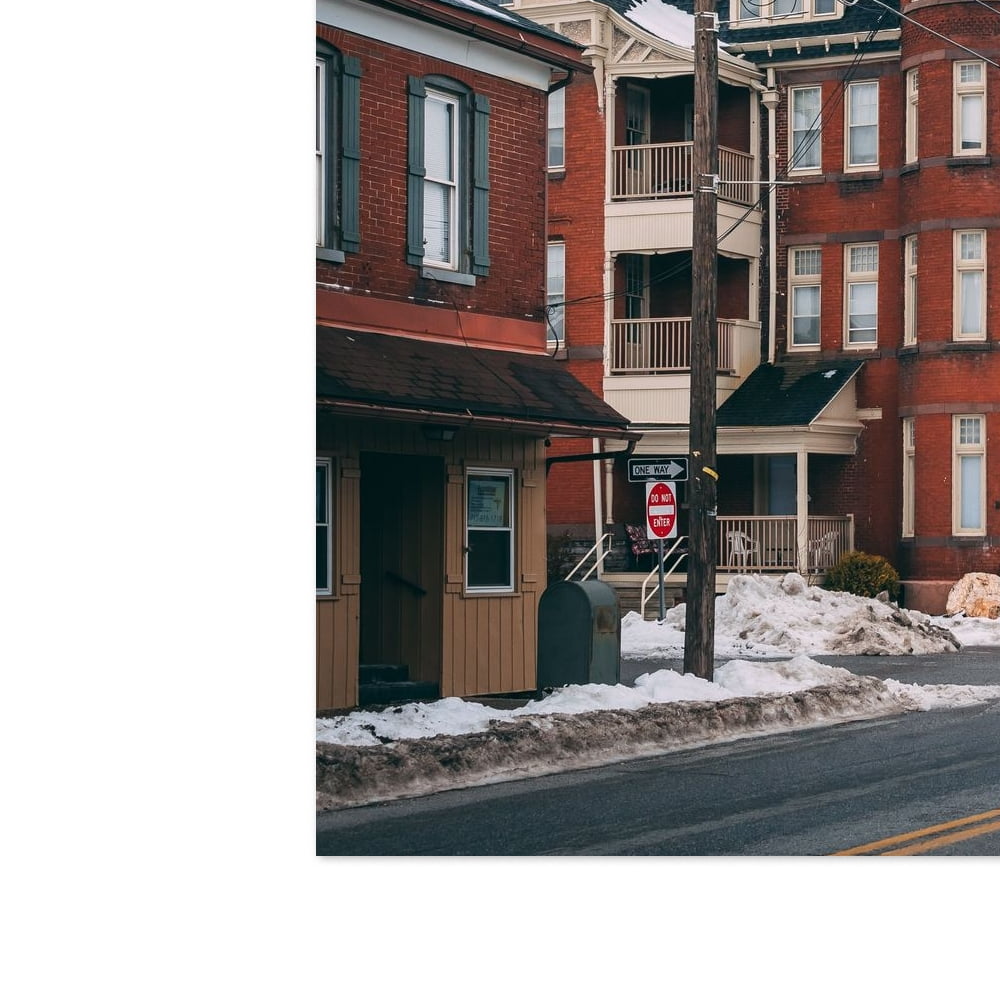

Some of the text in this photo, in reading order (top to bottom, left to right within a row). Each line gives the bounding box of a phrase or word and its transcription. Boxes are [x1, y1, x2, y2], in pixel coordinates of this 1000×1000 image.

[634, 465, 669, 474] ONE WAY
[651, 493, 672, 503] DO NOT
[653, 518, 671, 527] ENTER
